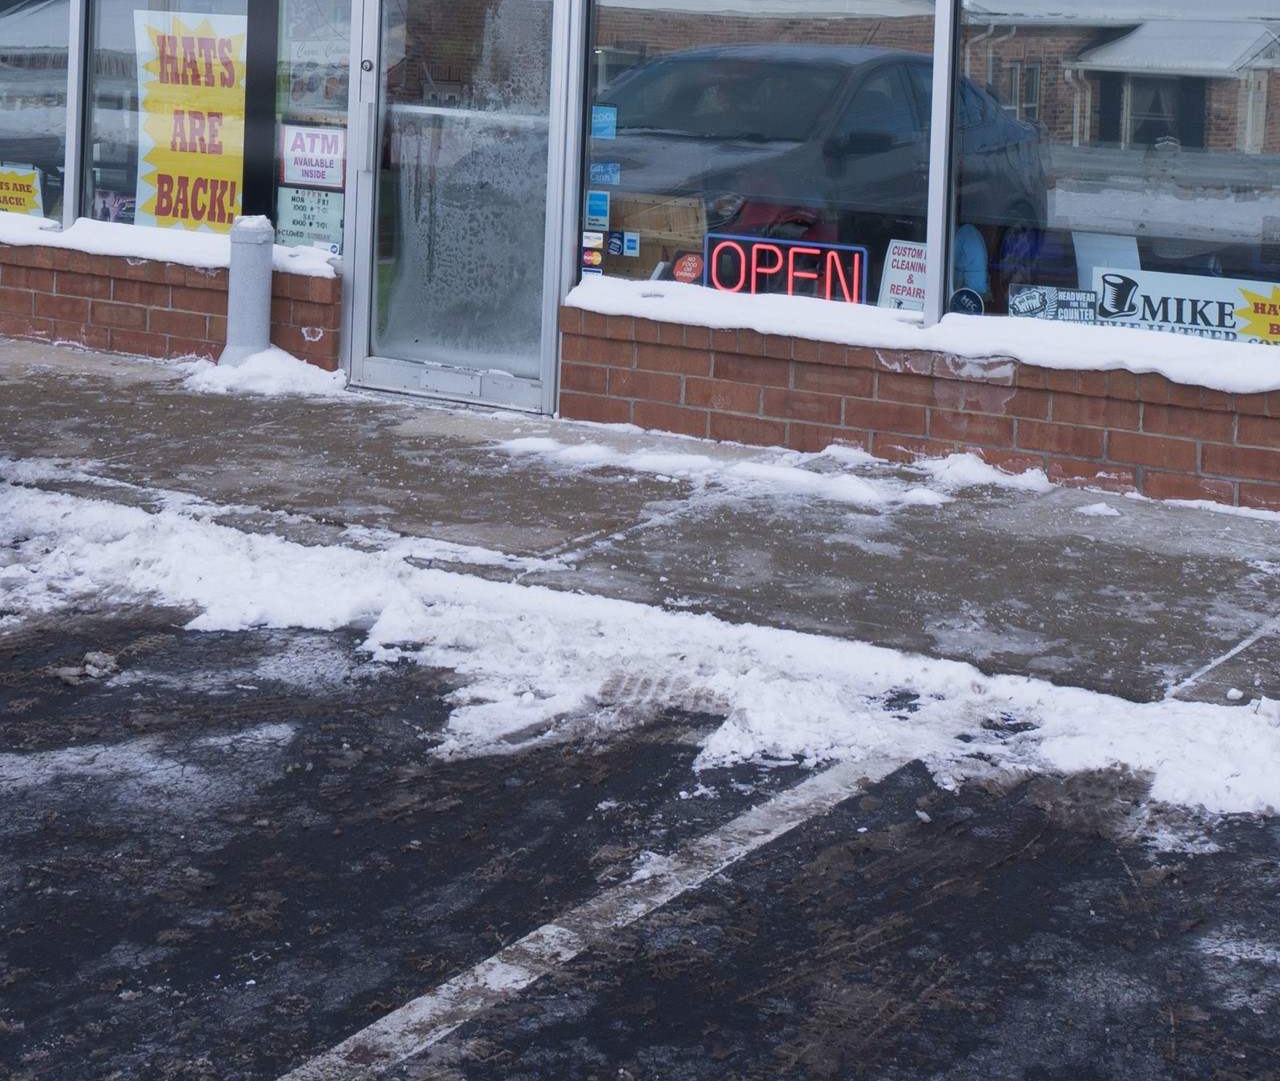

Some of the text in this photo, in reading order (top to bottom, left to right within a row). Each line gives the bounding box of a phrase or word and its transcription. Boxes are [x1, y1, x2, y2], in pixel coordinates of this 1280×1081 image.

[157, 35, 235, 88] HATS
[171, 109, 223, 155] ARE
[290, 132, 339, 154] ATM
[294, 157, 334, 168] AVAILABLE
[302, 169, 326, 179] INSIDE
[12, 183, 32, 193] ARE
[301, 190, 321, 198] OPEN
[155, 174, 237, 224] BACK!
[892, 246, 924, 260] CUSTOM
[907, 274, 914, 284] &
[1058, 291, 1096, 302] HEADWEAR
[1058, 308, 1094, 320] COUNTER
[1140, 294, 1237, 329] MIKE
